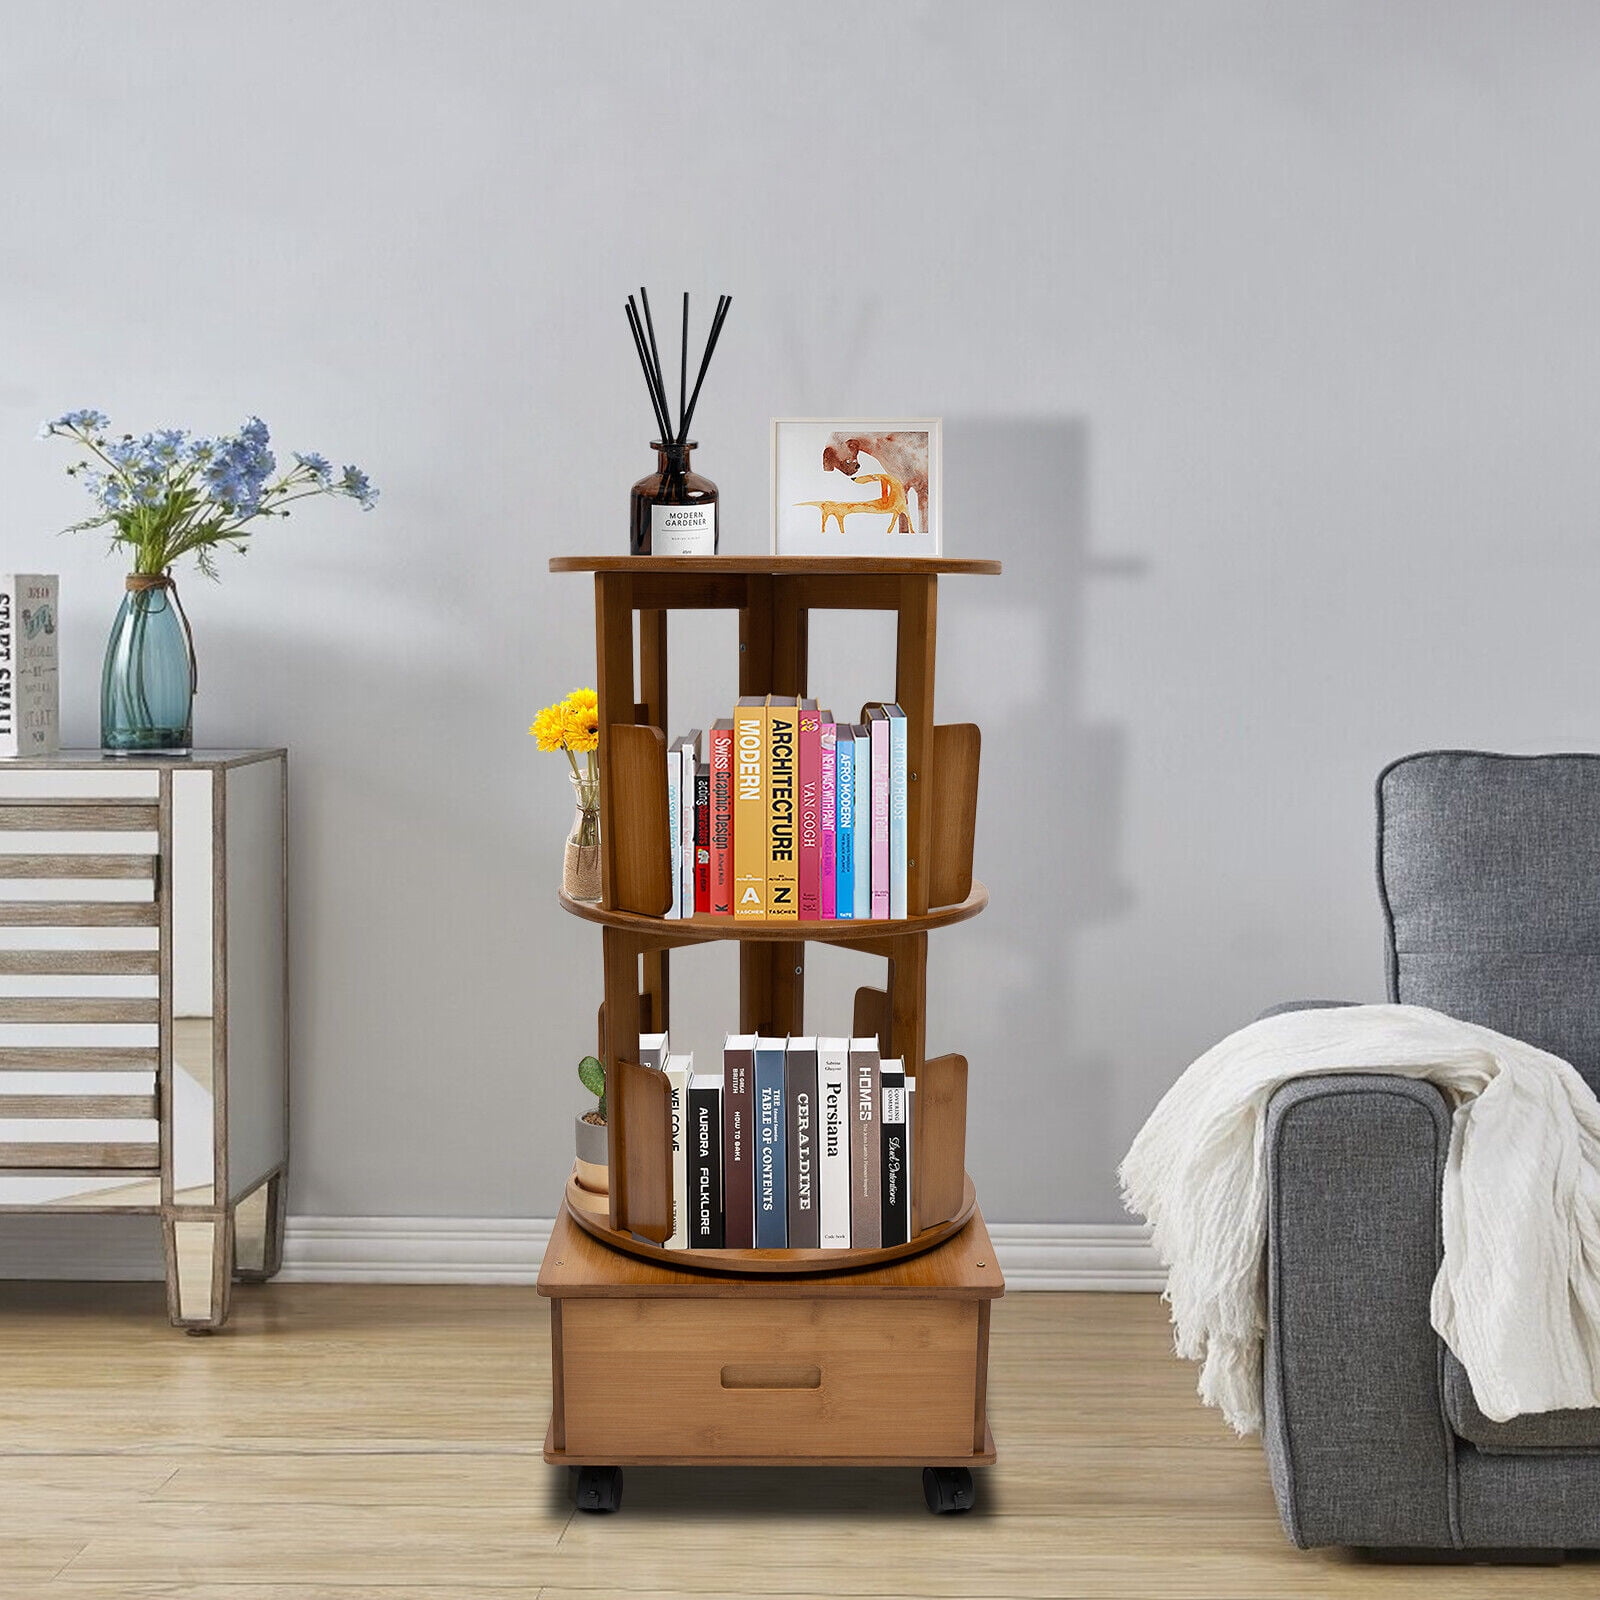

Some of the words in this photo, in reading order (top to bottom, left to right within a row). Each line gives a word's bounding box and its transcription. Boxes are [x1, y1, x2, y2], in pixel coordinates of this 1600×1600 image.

[665, 518, 707, 527] GARDENER
[669, 511, 704, 519] MODERN
[714, 737, 732, 769] Swiss
[739, 719, 761, 800] MODERN
[893, 736, 905, 755] ART
[840, 753, 851, 782] AFRO
[893, 757, 905, 784] DECO
[712, 771, 732, 812] Graphic
[771, 719, 793, 861] ARCHITECTURE
[804, 782, 816, 807] VAN
[840, 784, 851, 828] MODERN
[893, 787, 905, 820] HOUSE
[712, 814, 732, 850] Design
[804, 811, 816, 848] GOGH
[822, 810, 835, 832] PAINT
[740, 887, 761, 904] A
[761, 1087, 773, 1124] TABLE
[773, 1089, 781, 1106] THE
[859, 1067, 872, 1121] HOMES
[699, 1107, 709, 1158] AURORA
[734, 1130, 741, 1140] TO
[761, 1128, 773, 1144] OF
[826, 1082, 842, 1157] Persiana
[762, 1147, 773, 1211] CONTENTS
[700, 1167, 710, 1235] FOLKLORE
